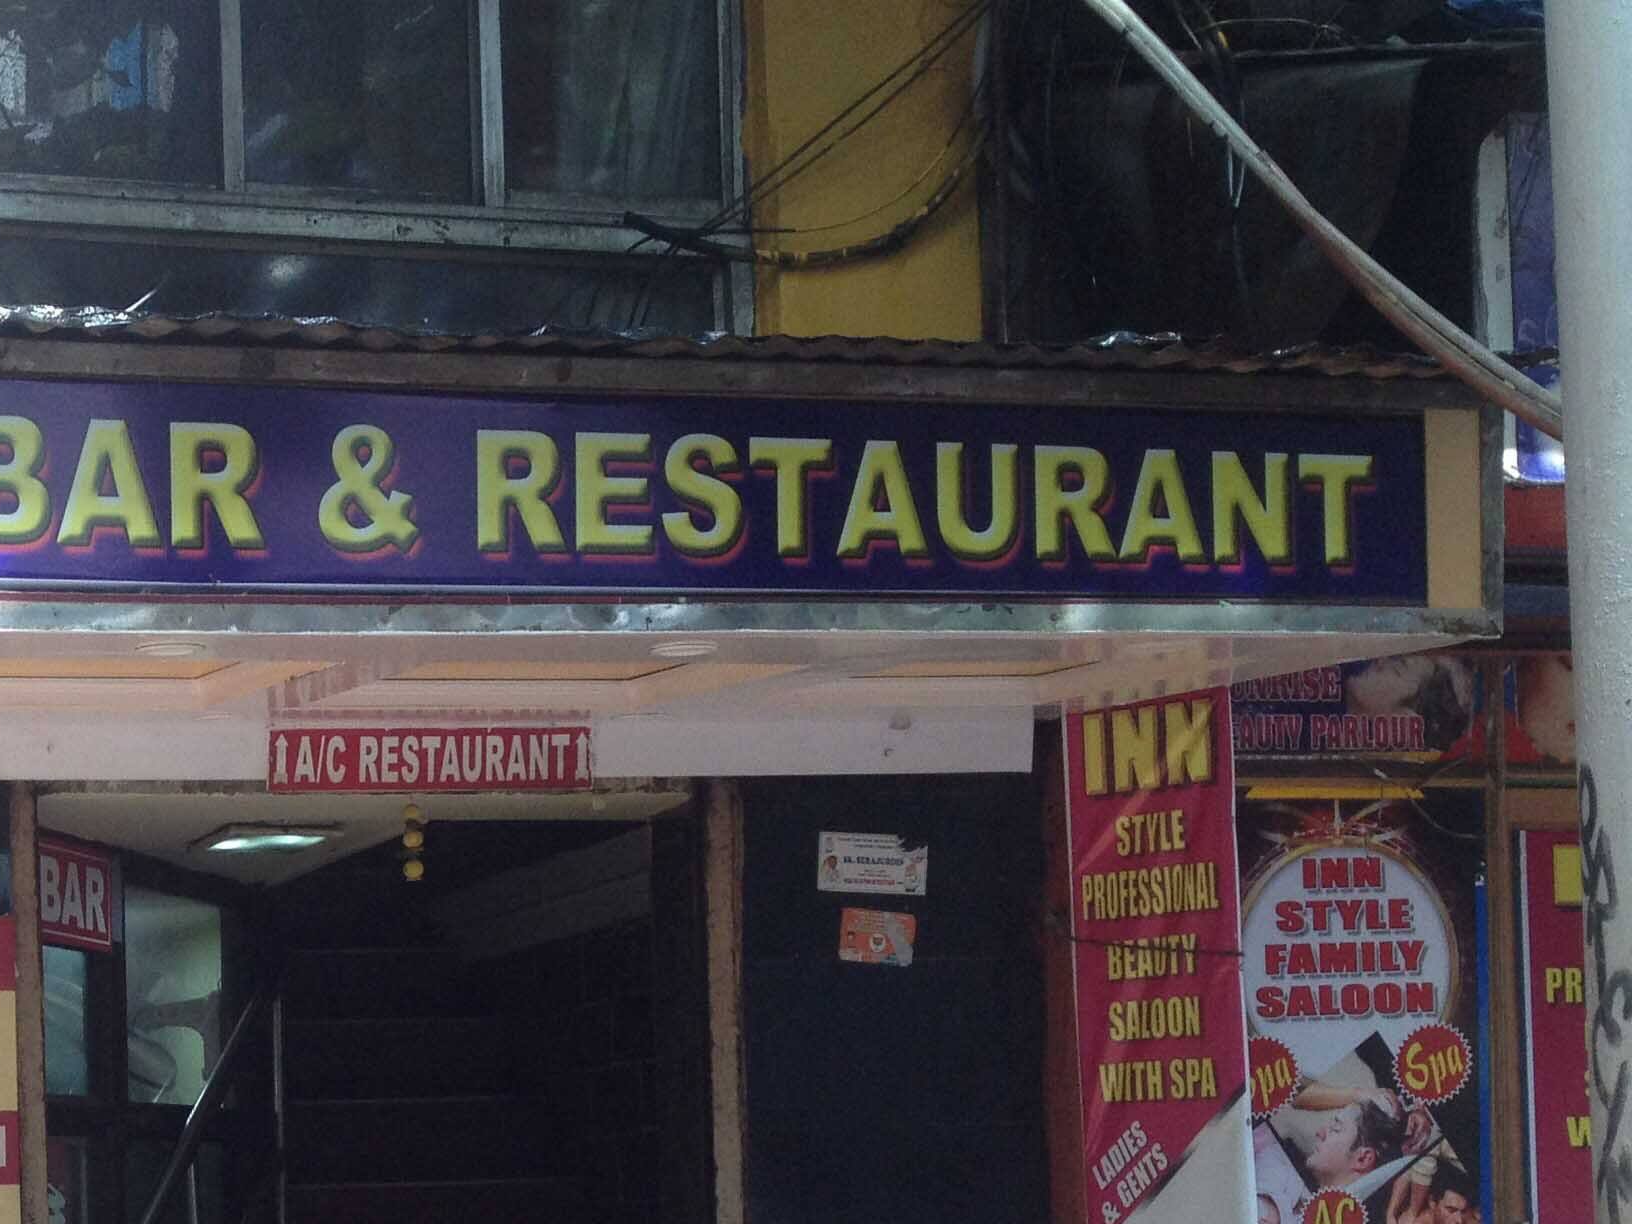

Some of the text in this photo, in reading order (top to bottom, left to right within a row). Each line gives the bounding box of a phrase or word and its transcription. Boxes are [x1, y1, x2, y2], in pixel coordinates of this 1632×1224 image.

[318, 424, 421, 551] &
[474, 428, 1376, 568] RESTAURANT
[1082, 698, 1214, 796] INN
[1232, 714, 1425, 749] AUTY PARLOUR
[294, 733, 570, 784] A/C RESTAURANT
[1116, 810, 1186, 856] STYLE
[39, 855, 107, 934] BAR
[1081, 862, 1219, 920] PROFESSIONAL
[1302, 857, 1382, 889] INN
[1275, 898, 1414, 934] STYLE
[1108, 933, 1197, 981] BEAUTY
[1264, 940, 1425, 976] FAMILY
[1109, 996, 1201, 1041] SALOON
[1255, 982, 1436, 1020] SALOON
[1099, 1057, 1217, 1103] WITH SPA
[1250, 1058, 1293, 1108] pa
[1405, 1041, 1464, 1096] Spa
[1092, 1120, 1148, 1190] LADIES
[1117, 1142, 1168, 1208] GENTS
